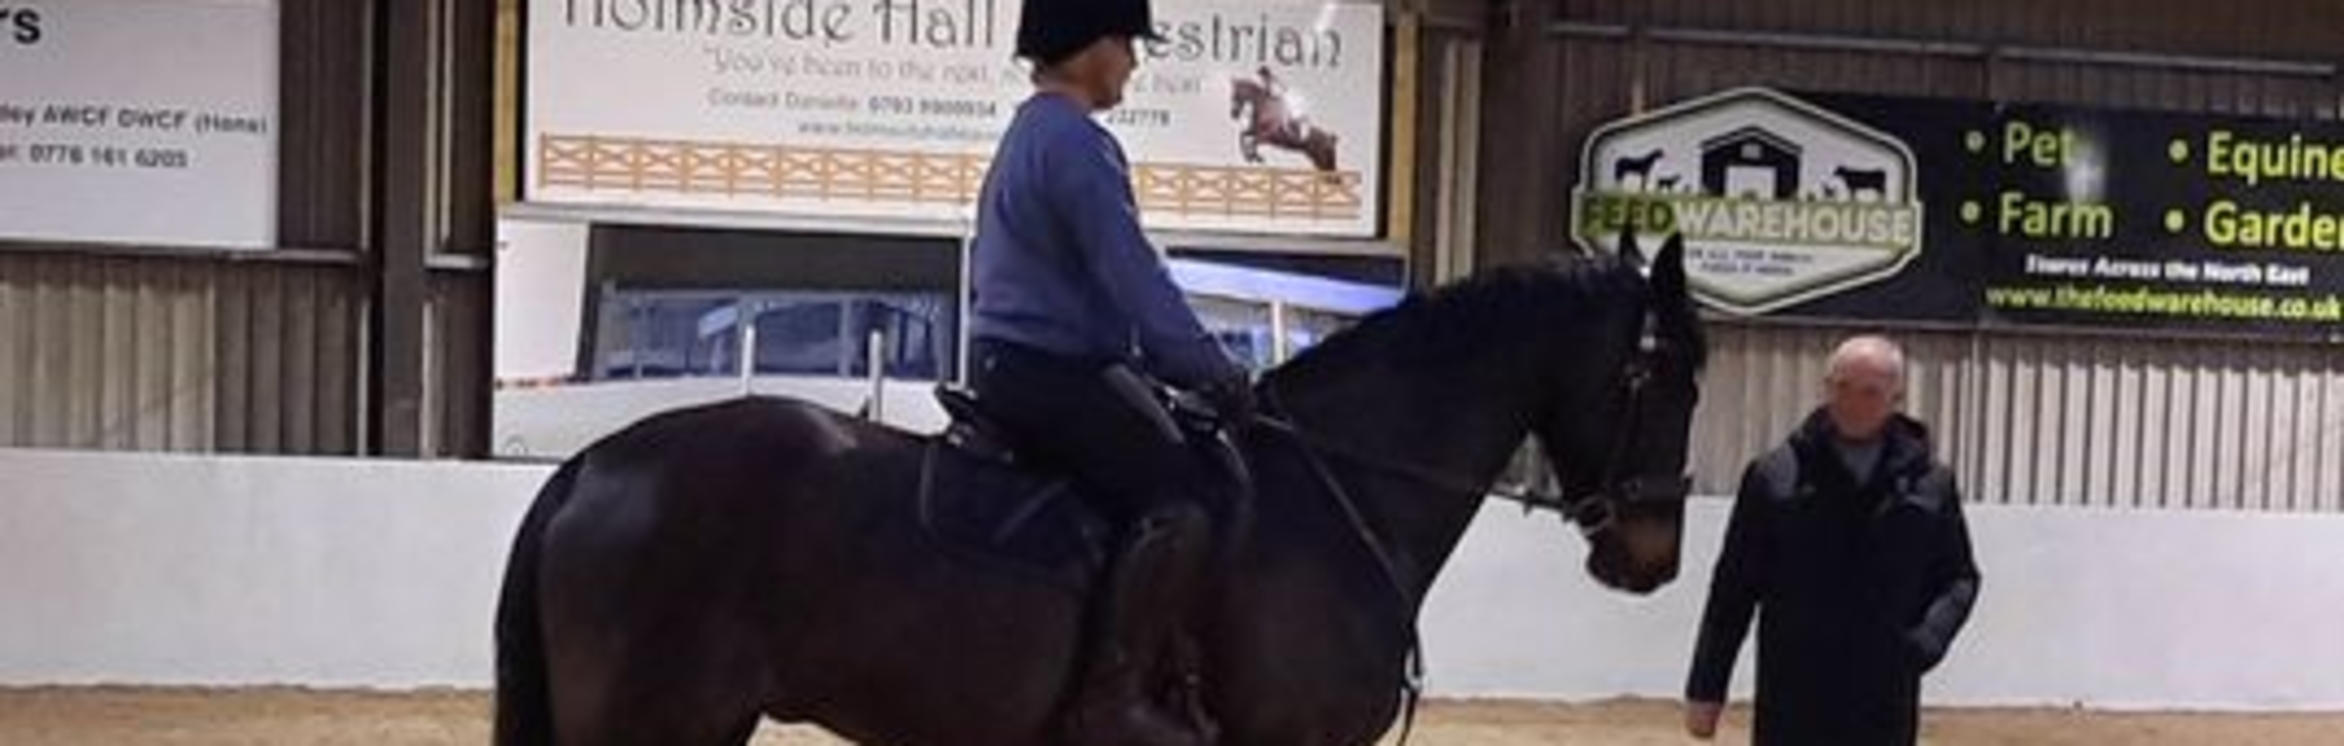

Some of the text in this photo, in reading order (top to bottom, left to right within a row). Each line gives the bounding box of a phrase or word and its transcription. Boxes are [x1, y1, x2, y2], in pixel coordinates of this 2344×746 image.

[2003, 120, 2078, 168] Pet
[2206, 130, 2344, 186] Equine
[2000, 192, 2114, 239] Farm
[2094, 257, 2161, 280] Across
[2164, 261, 2199, 282] the
[2203, 262, 2263, 286] North
[2265, 264, 2310, 287] East
